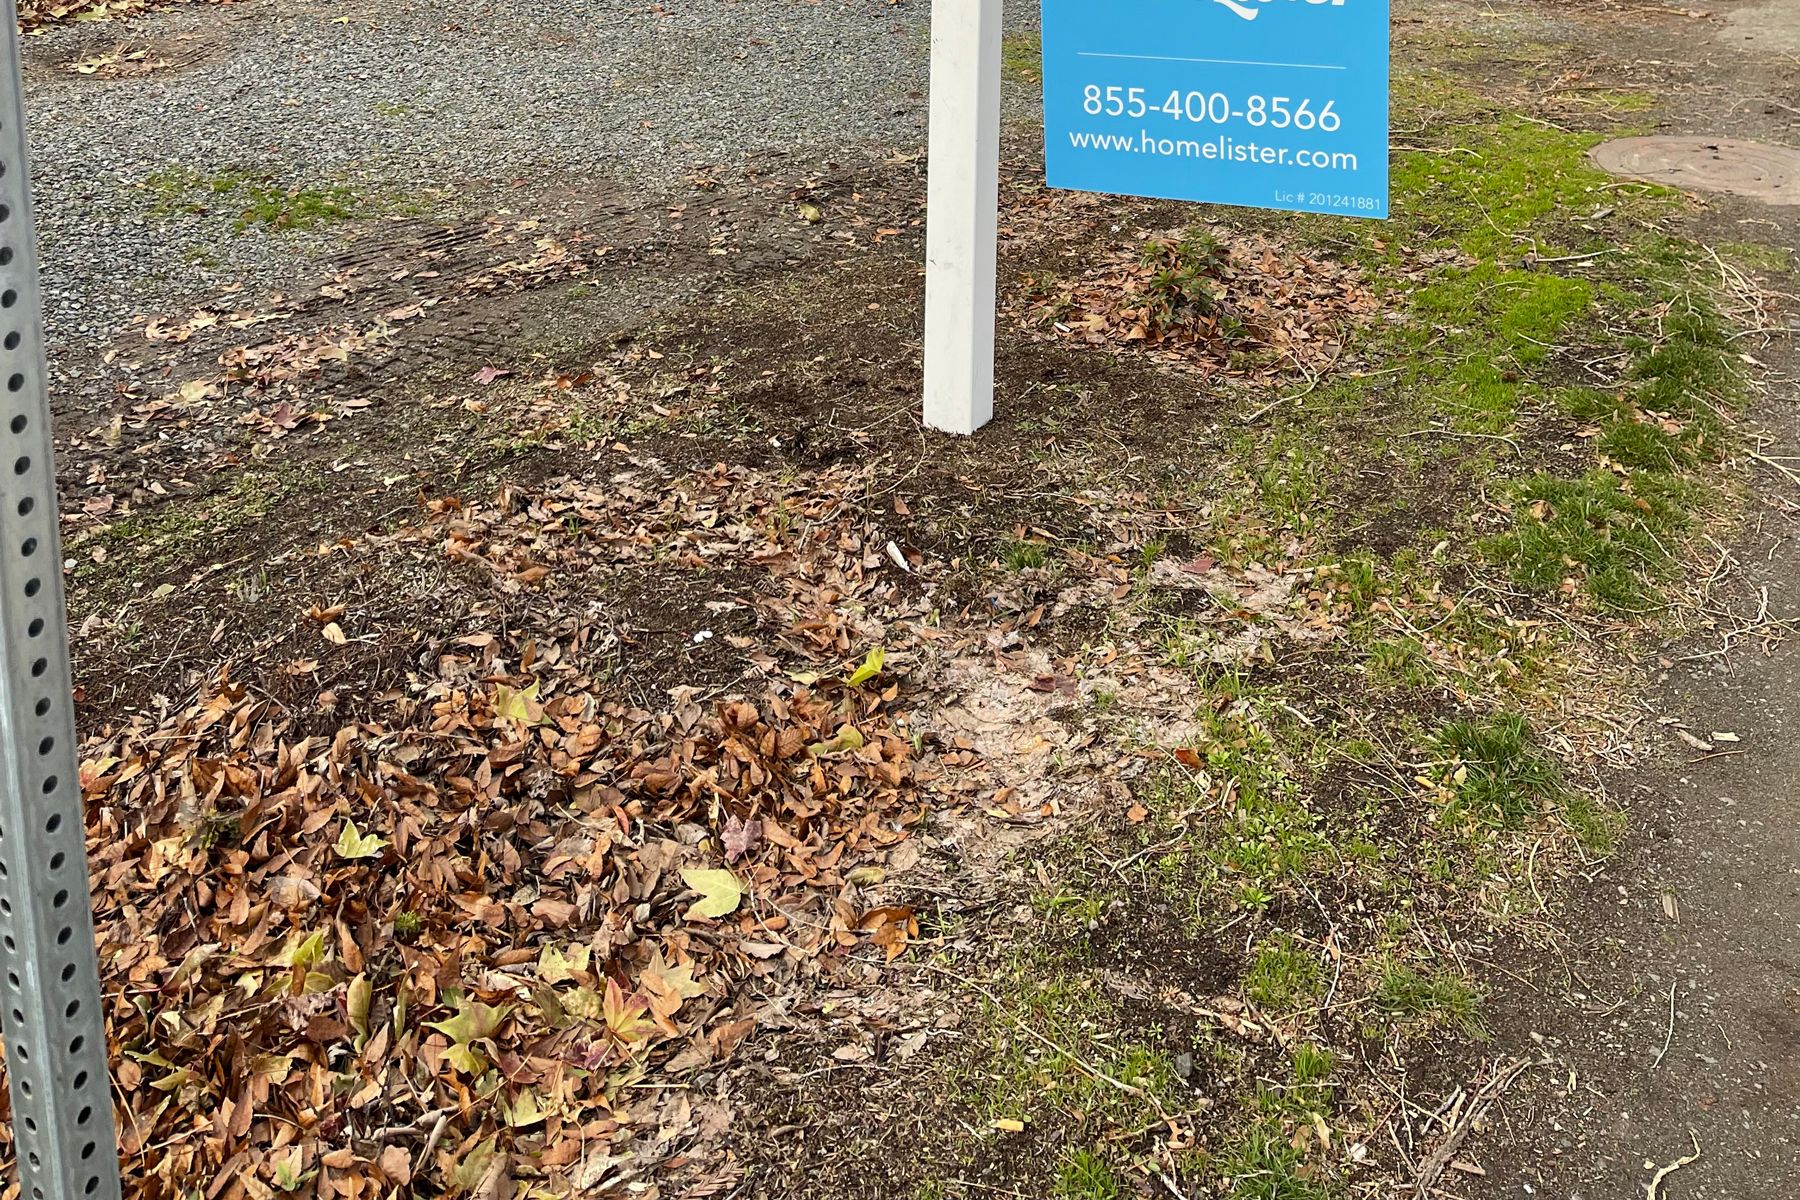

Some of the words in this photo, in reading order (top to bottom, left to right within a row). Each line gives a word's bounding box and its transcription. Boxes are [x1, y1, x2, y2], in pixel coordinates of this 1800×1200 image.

[1083, 84, 1341, 132] 855-400-8566
[1069, 129, 1357, 171] www.homelister.com
[1275, 190, 1294, 203] Lic
[1308, 192, 1380, 211] 201241881
